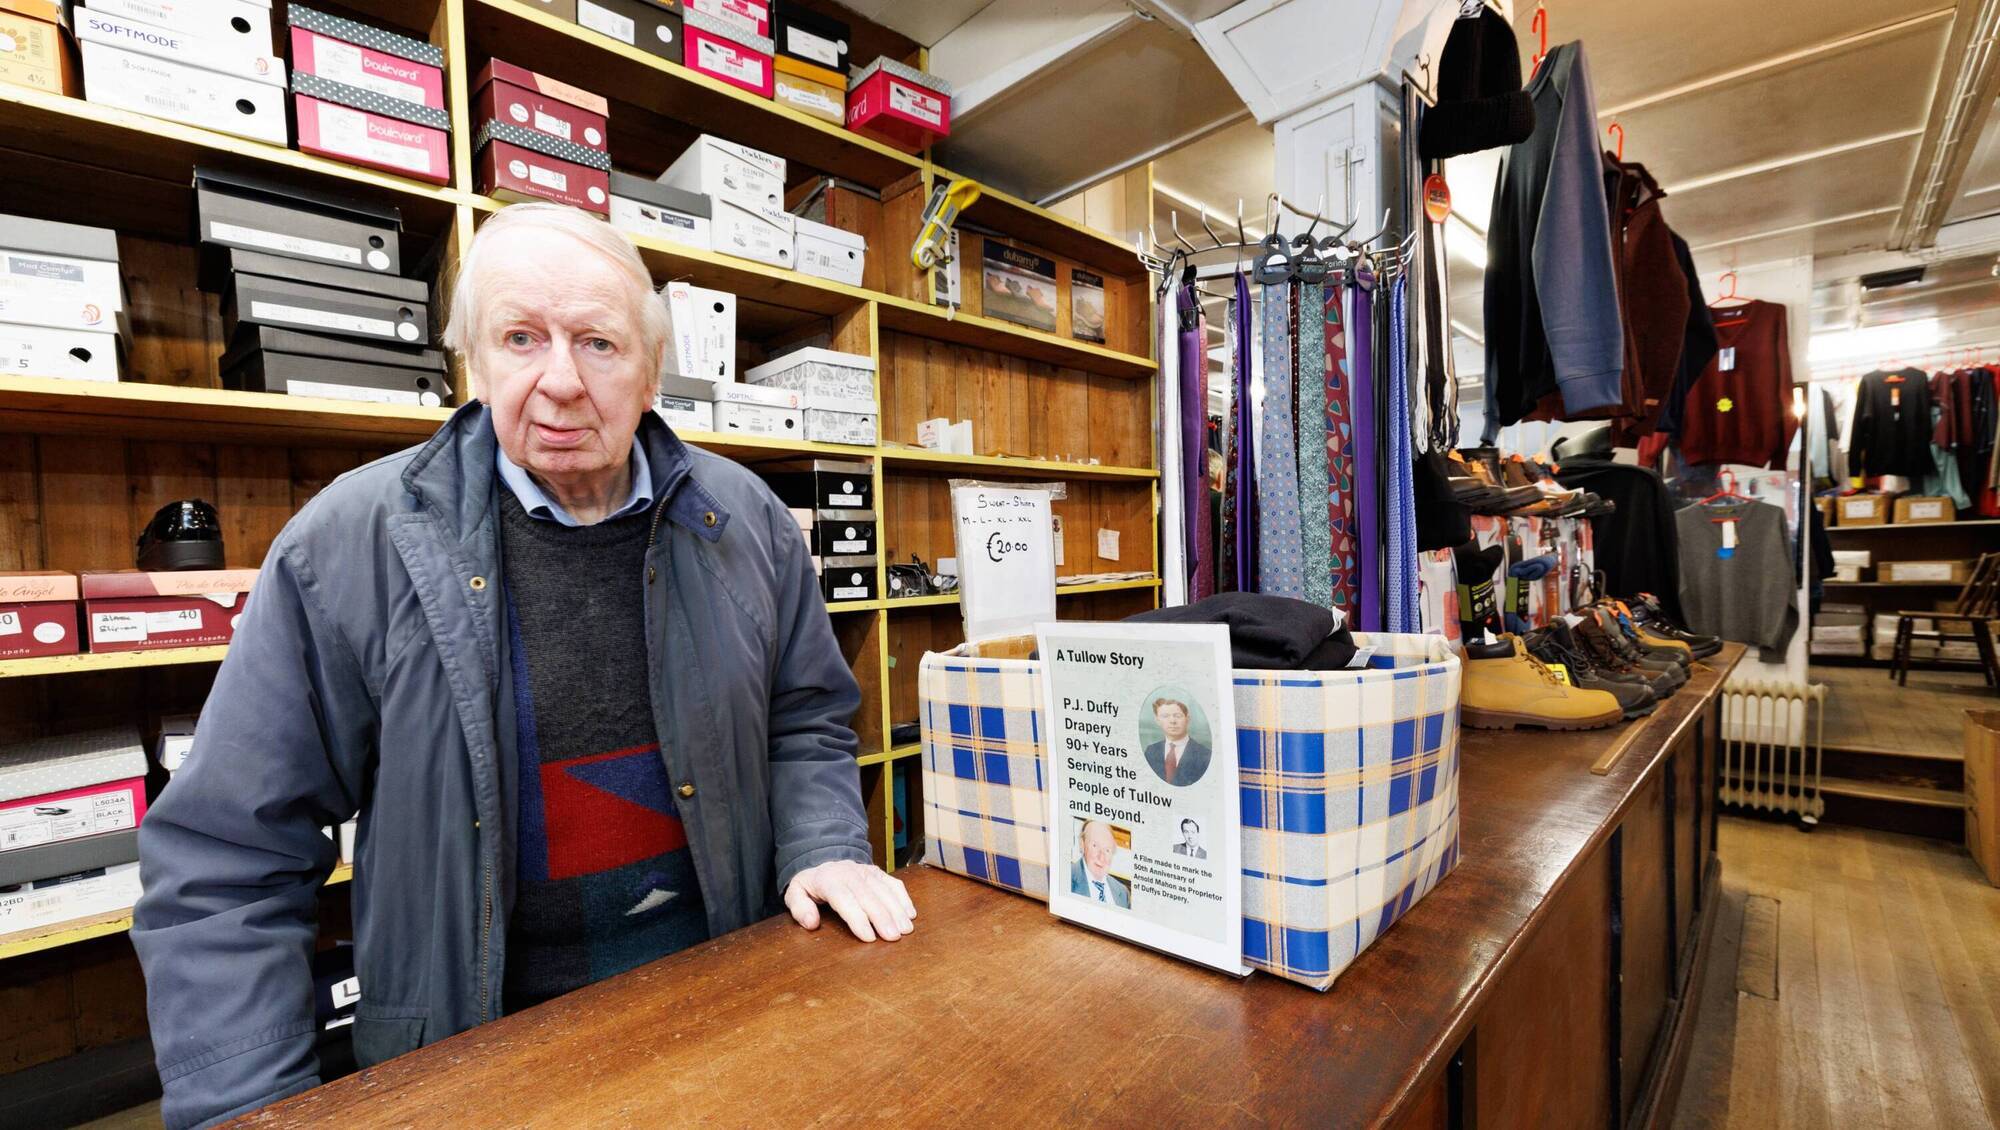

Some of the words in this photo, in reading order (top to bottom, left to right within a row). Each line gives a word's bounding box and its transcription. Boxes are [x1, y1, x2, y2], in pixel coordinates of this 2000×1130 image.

[89, 18, 180, 50] SOFTMODE
[1003, 250, 1034, 270] dubarry
[18, 358, 29, 368] 5
[962, 516, 970, 524] M
[12, 586, 56, 599] Angel
[0, 614, 13, 625] 0
[178, 610, 197, 620] 40
[1056, 649, 1065, 661] A
[1067, 650, 1106, 664] Tullow
[1110, 652, 1144, 669] Story
[1064, 698, 1084, 712] P.J.
[1087, 700, 1119, 718] Duffy
[1065, 718, 1111, 737] Drapery
[1066, 738, 1089, 750] 90+
[1092, 741, 1128, 758] Years
[1067, 758, 1113, 778] Serving
[1116, 765, 1137, 780] the
[1068, 778, 1109, 797] People
[1113, 786, 1126, 799] of
[1129, 788, 1172, 808] Tullow
[96, 810, 123, 818] BLACK
[1069, 800, 1091, 812] and
[1095, 802, 1145, 824] Beyond.
[1134, 863, 1148, 872] 50th
[1150, 868, 1187, 883] Anniversary
[1140, 855, 1153, 863] Film
[1154, 859, 1172, 868] made
[1182, 866, 1199, 875] mark
[1134, 873, 1153, 883] Arnold
[1155, 878, 1177, 890] Mahon
[1188, 887, 1222, 901] Proprietor
[1141, 885, 1160, 896] Duffys
[1162, 890, 1190, 904] Drapery.
